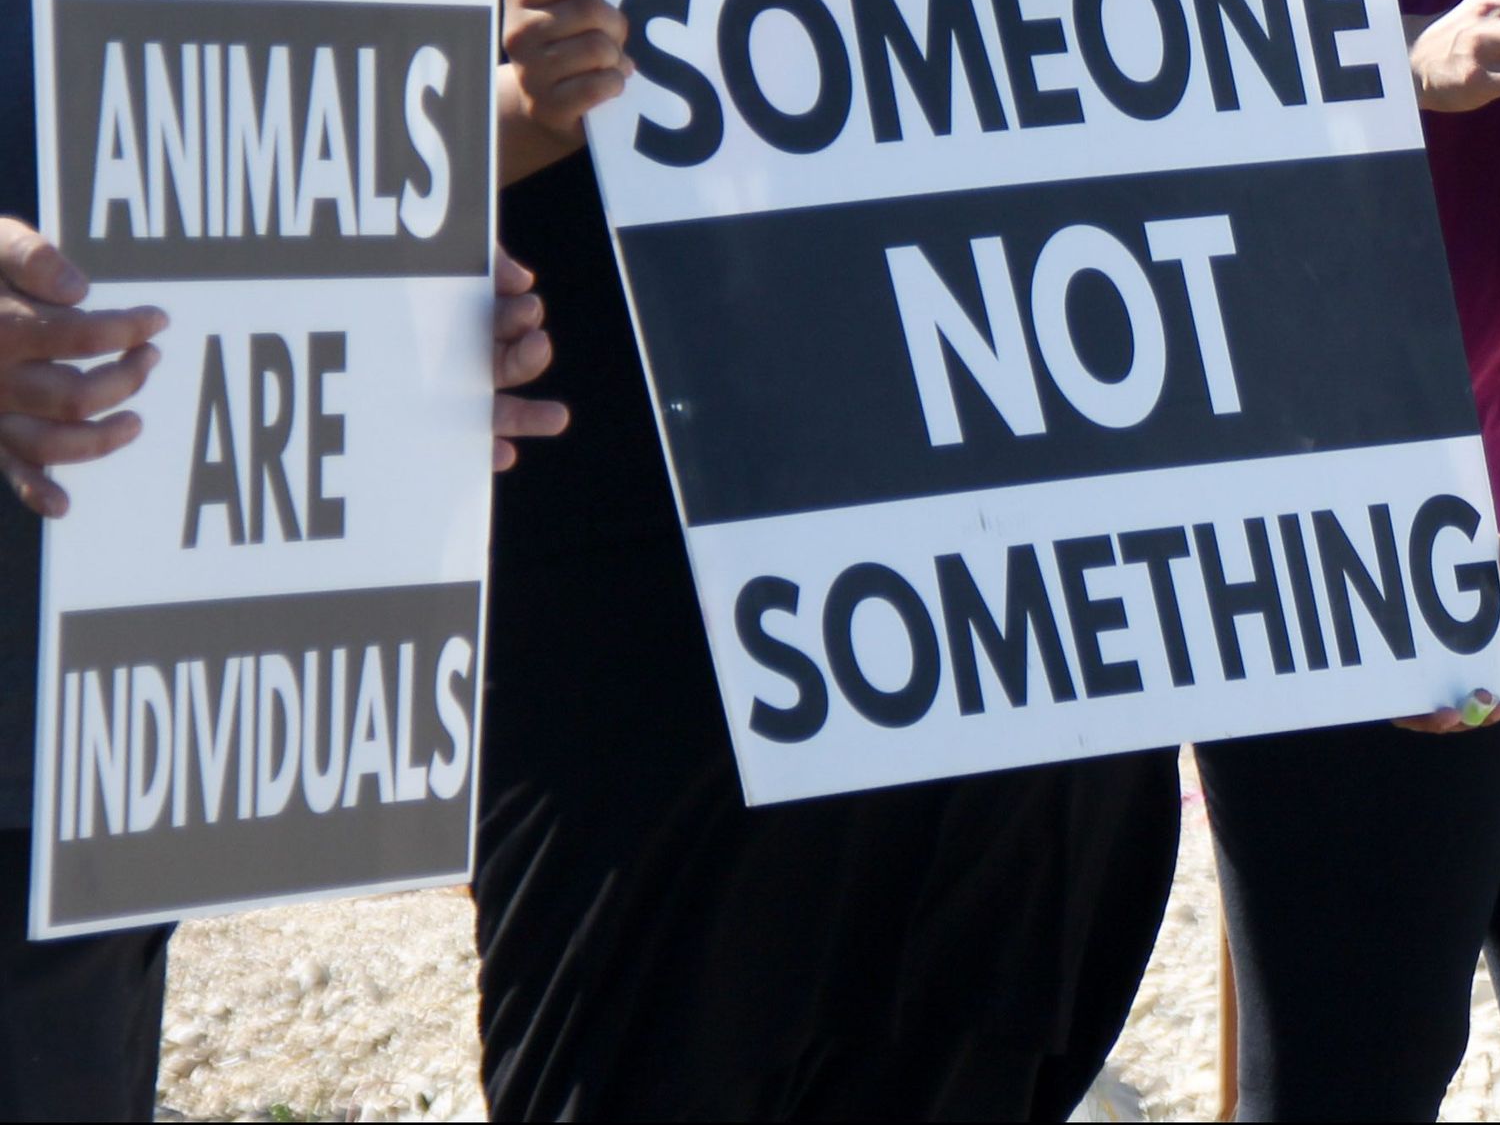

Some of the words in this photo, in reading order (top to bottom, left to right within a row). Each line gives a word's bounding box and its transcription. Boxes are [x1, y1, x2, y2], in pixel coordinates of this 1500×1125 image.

[89, 39, 453, 240] ANIMALS
[884, 214, 1243, 448] NOT
[181, 329, 348, 550] ARE
[60, 634, 474, 843] INDIVIDUALS
